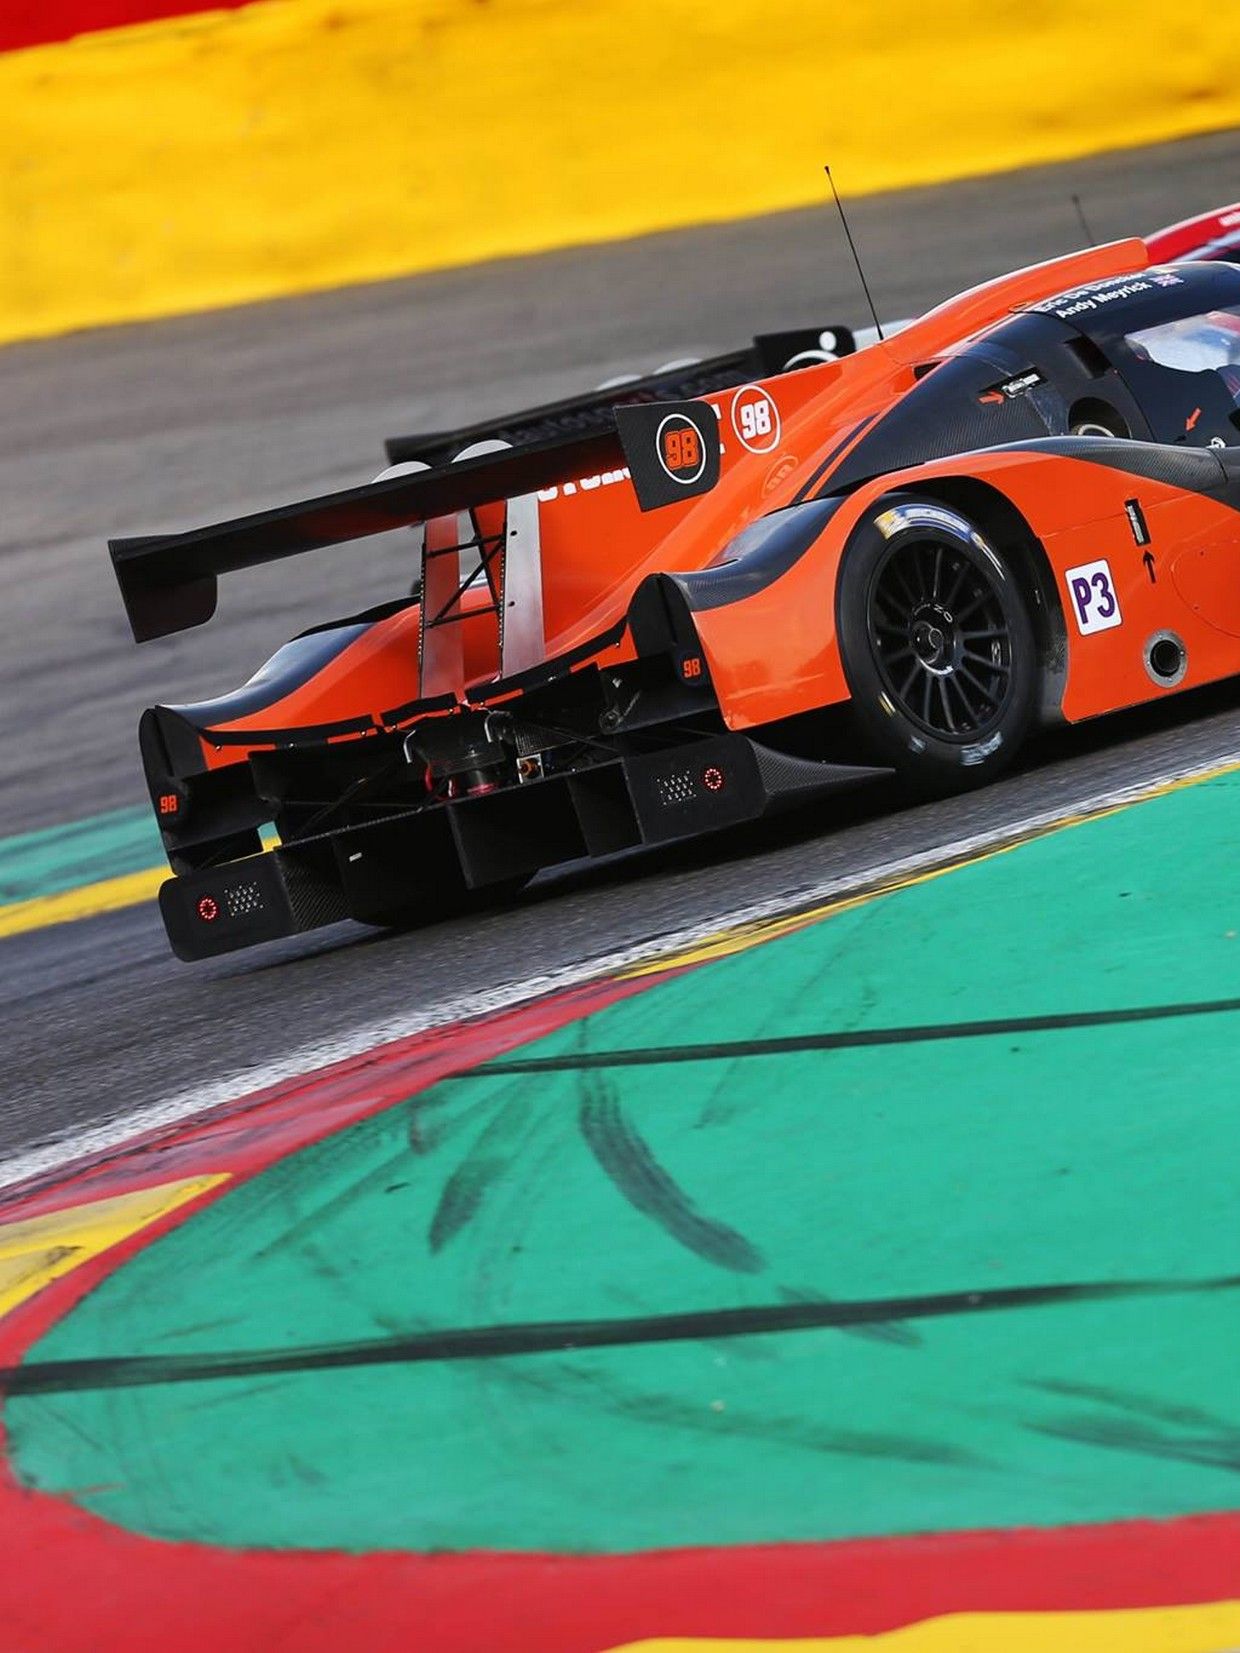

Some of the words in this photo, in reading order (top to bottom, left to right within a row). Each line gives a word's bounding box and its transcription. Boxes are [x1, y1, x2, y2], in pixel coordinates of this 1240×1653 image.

[1055, 298, 1097, 319] Andy
[1092, 281, 1153, 303] Meyrick
[740, 399, 772, 440] 98
[665, 427, 699, 471] 98
[1072, 572, 1115, 624] P3
[683, 658, 701, 678] 98
[160, 794, 177, 814] 98
